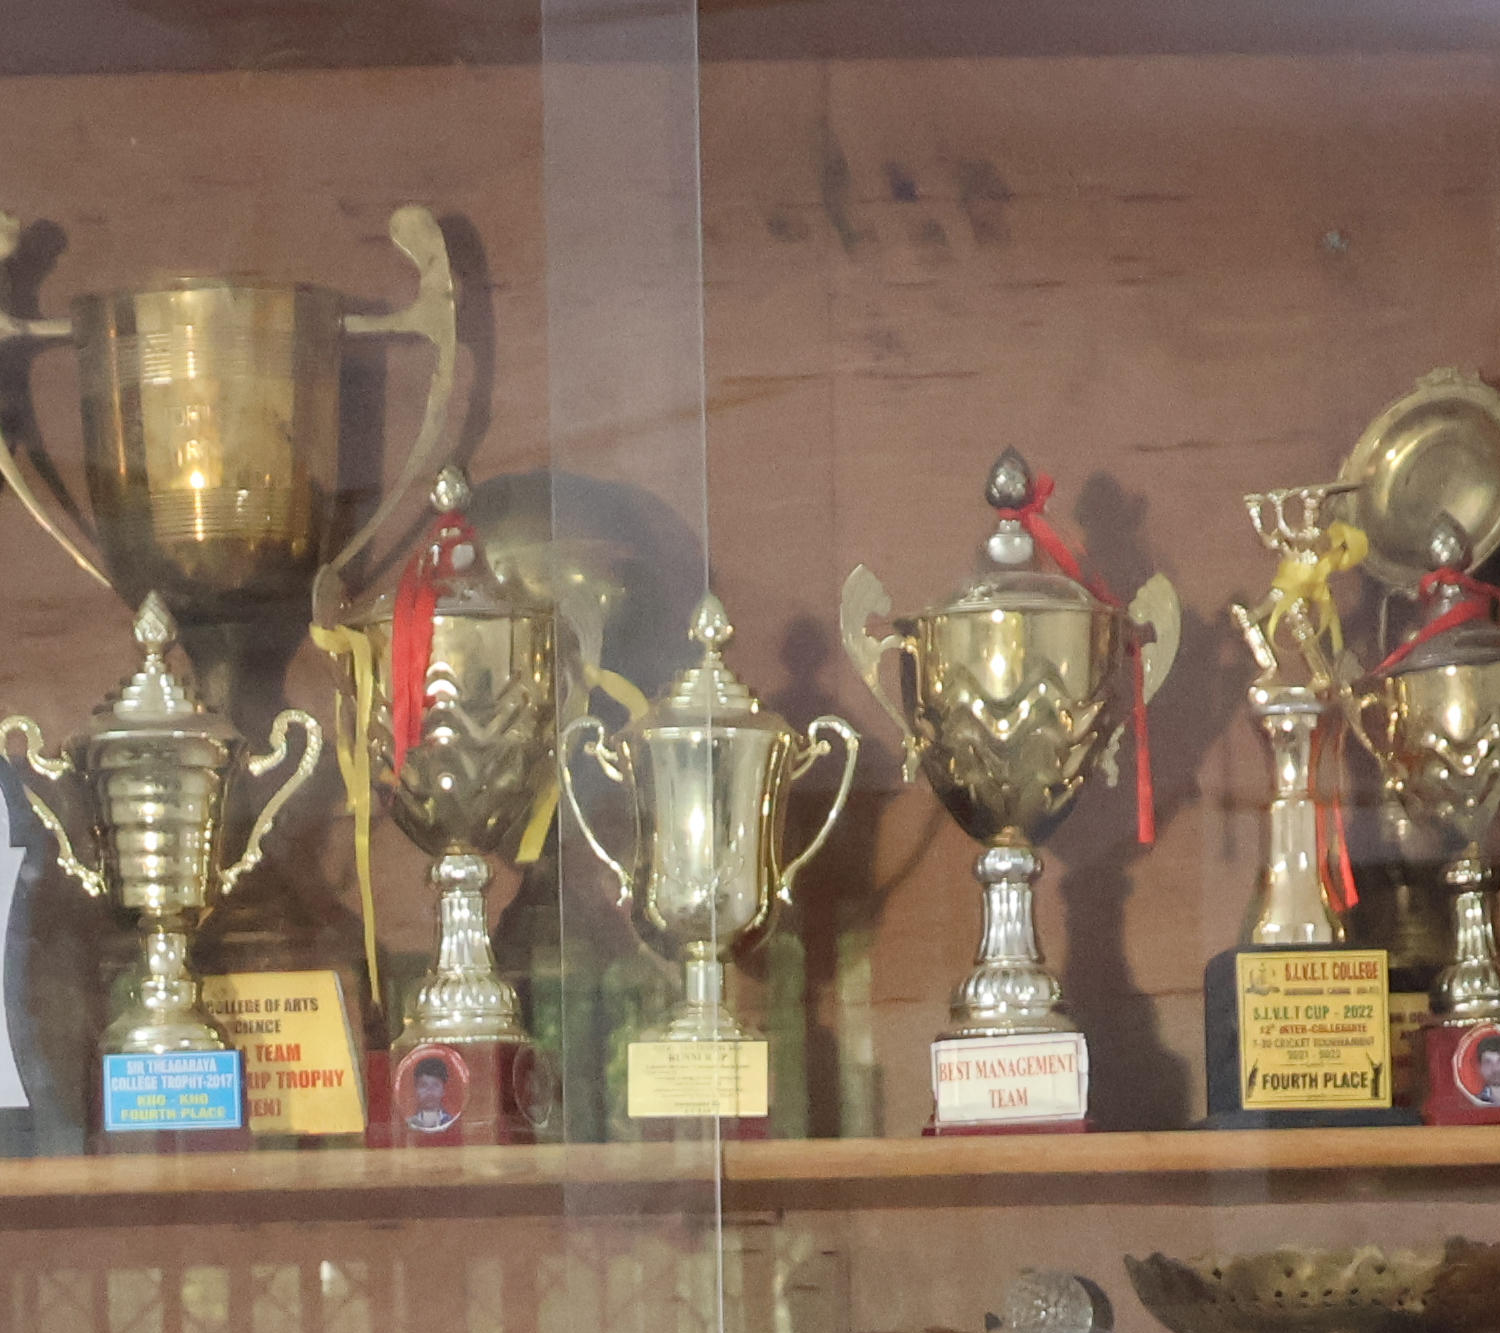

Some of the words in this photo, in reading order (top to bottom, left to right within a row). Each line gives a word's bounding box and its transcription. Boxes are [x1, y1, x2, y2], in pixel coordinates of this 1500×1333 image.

[1333, 960, 1378, 980] COLLEGE
[265, 998, 280, 1012] OF
[284, 997, 318, 1012] ARTS
[1305, 1004, 1330, 1020] CUP
[1343, 1004, 1373, 1019] 2022
[256, 1043, 302, 1063] TEAM
[126, 1060, 145, 1074] SIR
[939, 1060, 972, 1081] BEST
[976, 1053, 1075, 1080] MANAGEMENT
[111, 1075, 158, 1090] COLLEGE
[162, 1073, 233, 1090] TROPHY-2017
[278, 1069, 345, 1089] TROPHY
[1262, 1072, 1318, 1091] FOURTH
[1323, 1070, 1368, 1089] PLACE
[989, 1086, 1029, 1109] TEAM
[121, 1108, 176, 1121] FOURTH
[180, 1106, 226, 1119] PLACE
